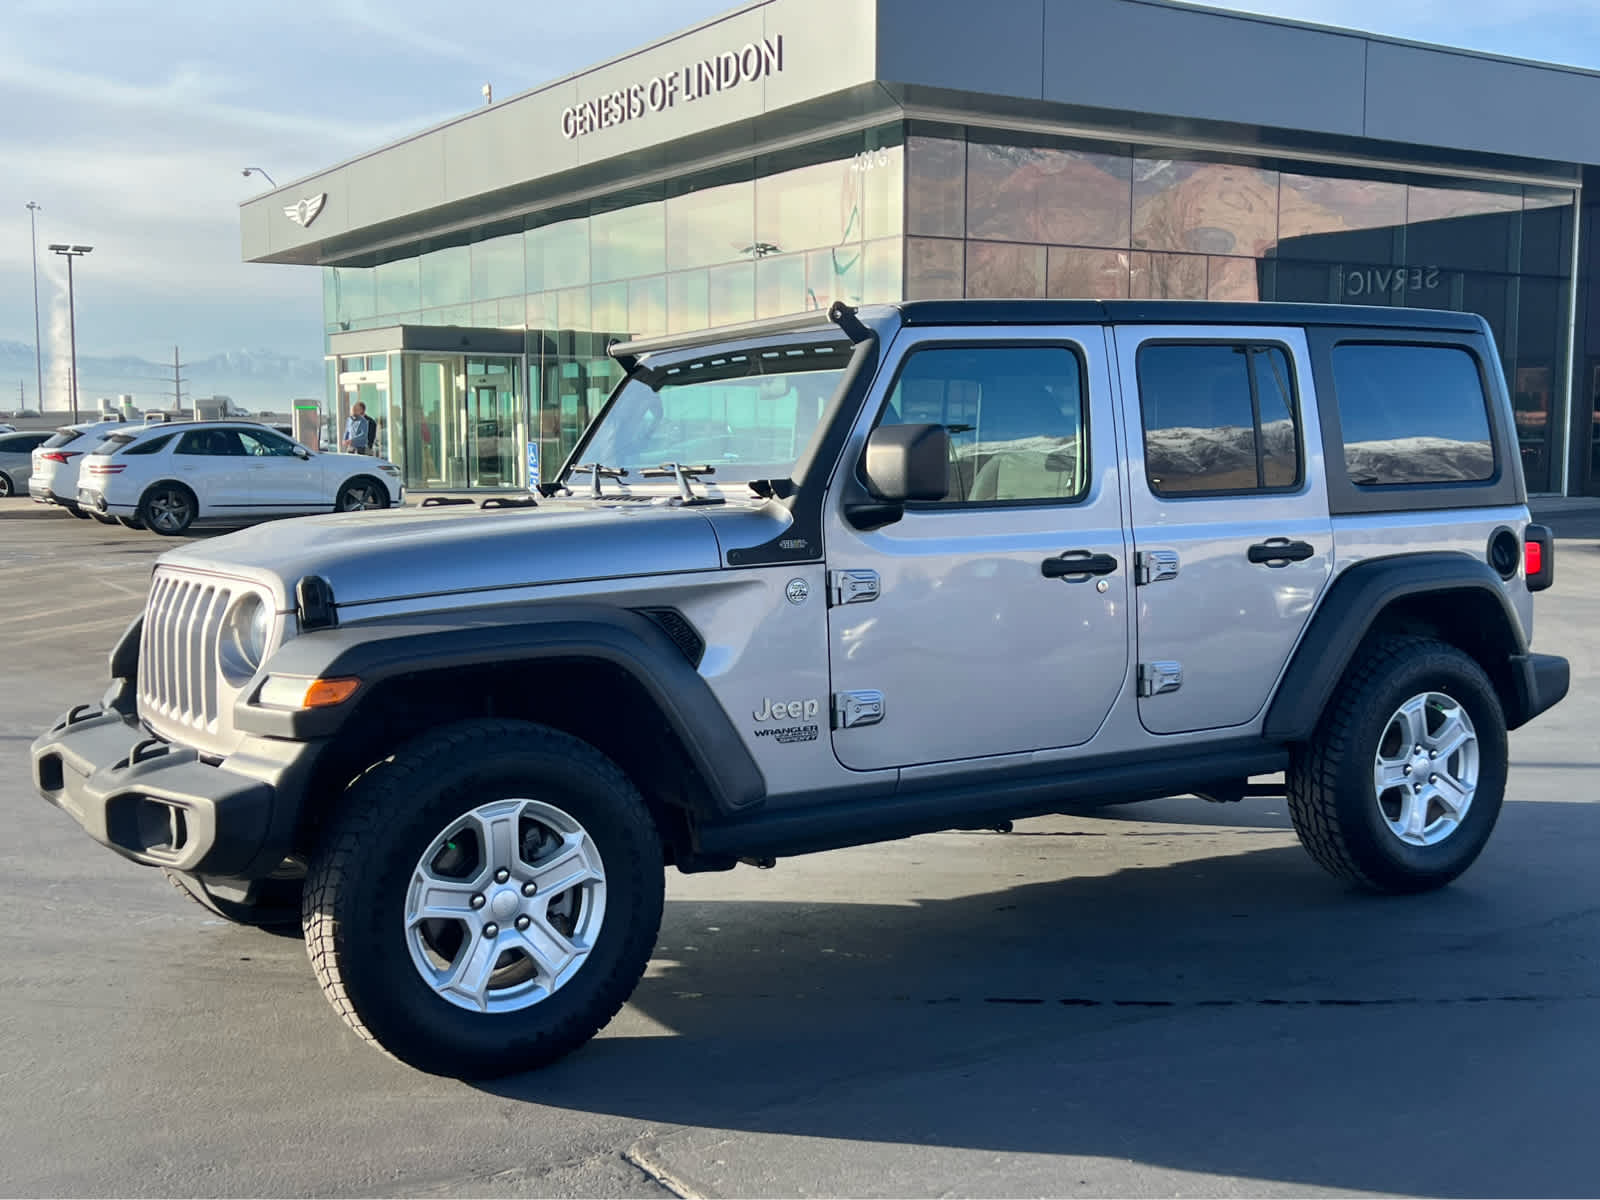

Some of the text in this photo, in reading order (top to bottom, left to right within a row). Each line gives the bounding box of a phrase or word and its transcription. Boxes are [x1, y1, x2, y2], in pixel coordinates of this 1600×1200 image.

[561, 34, 783, 139] GENESIS OF LINDON
[753, 697, 819, 722] Jeep
[754, 725, 818, 737] WRANGLER
